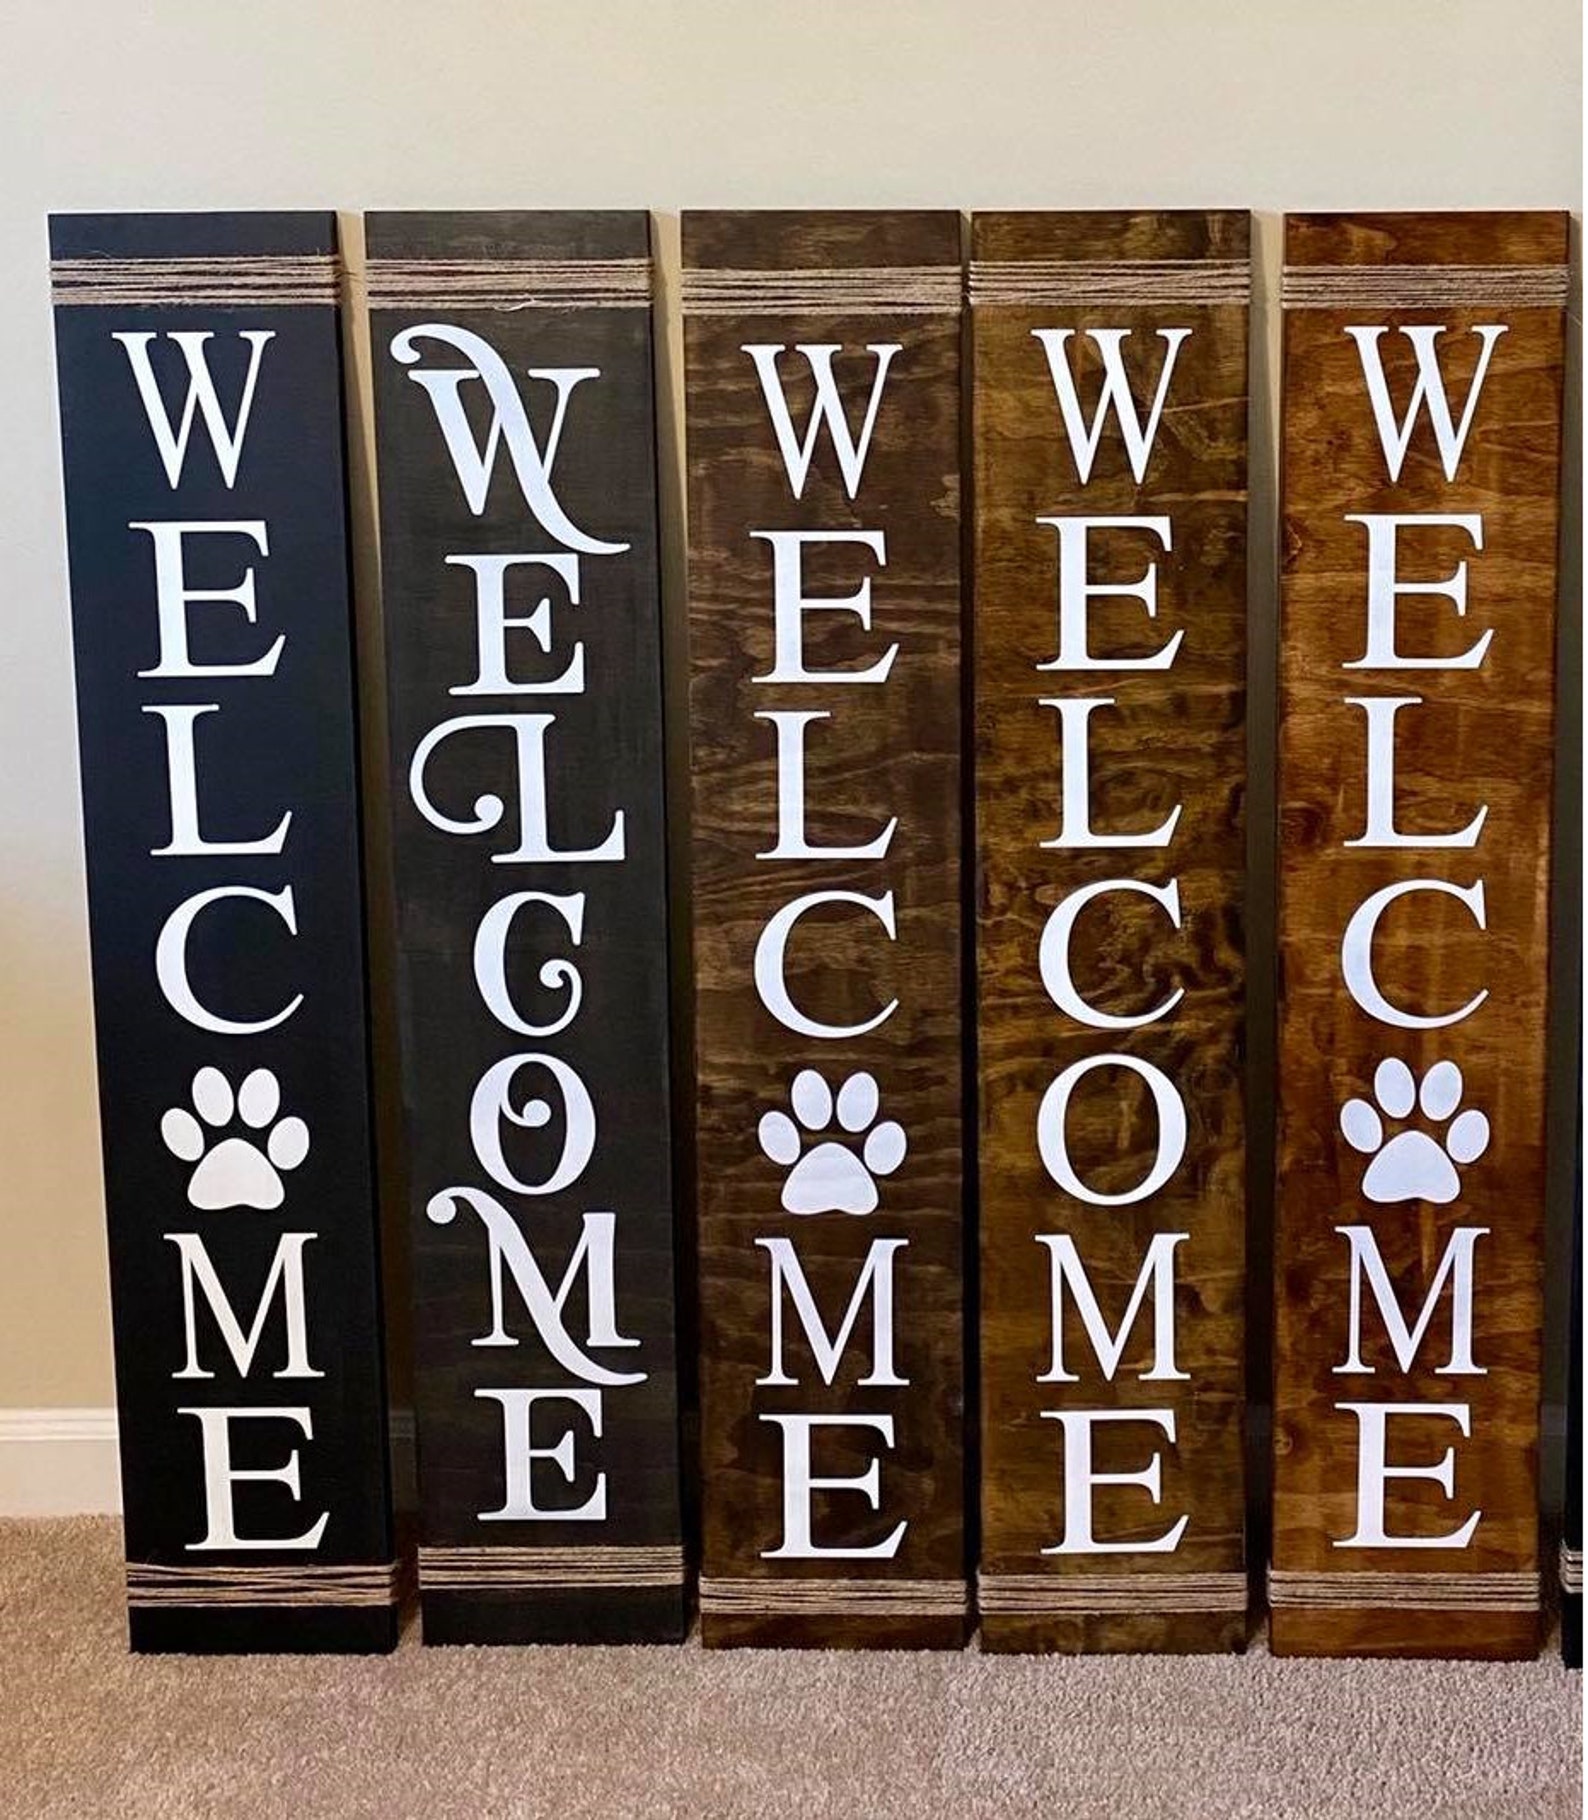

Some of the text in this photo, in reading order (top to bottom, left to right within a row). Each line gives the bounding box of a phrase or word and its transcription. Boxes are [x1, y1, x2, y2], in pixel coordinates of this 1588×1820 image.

[111, 330, 331, 1551] WELCME
[390, 323, 648, 1522] WELCOME
[740, 344, 910, 1559] WELCME
[1030, 328, 1193, 1555] WELCOME
[1331, 325, 1510, 1549] WELCME
